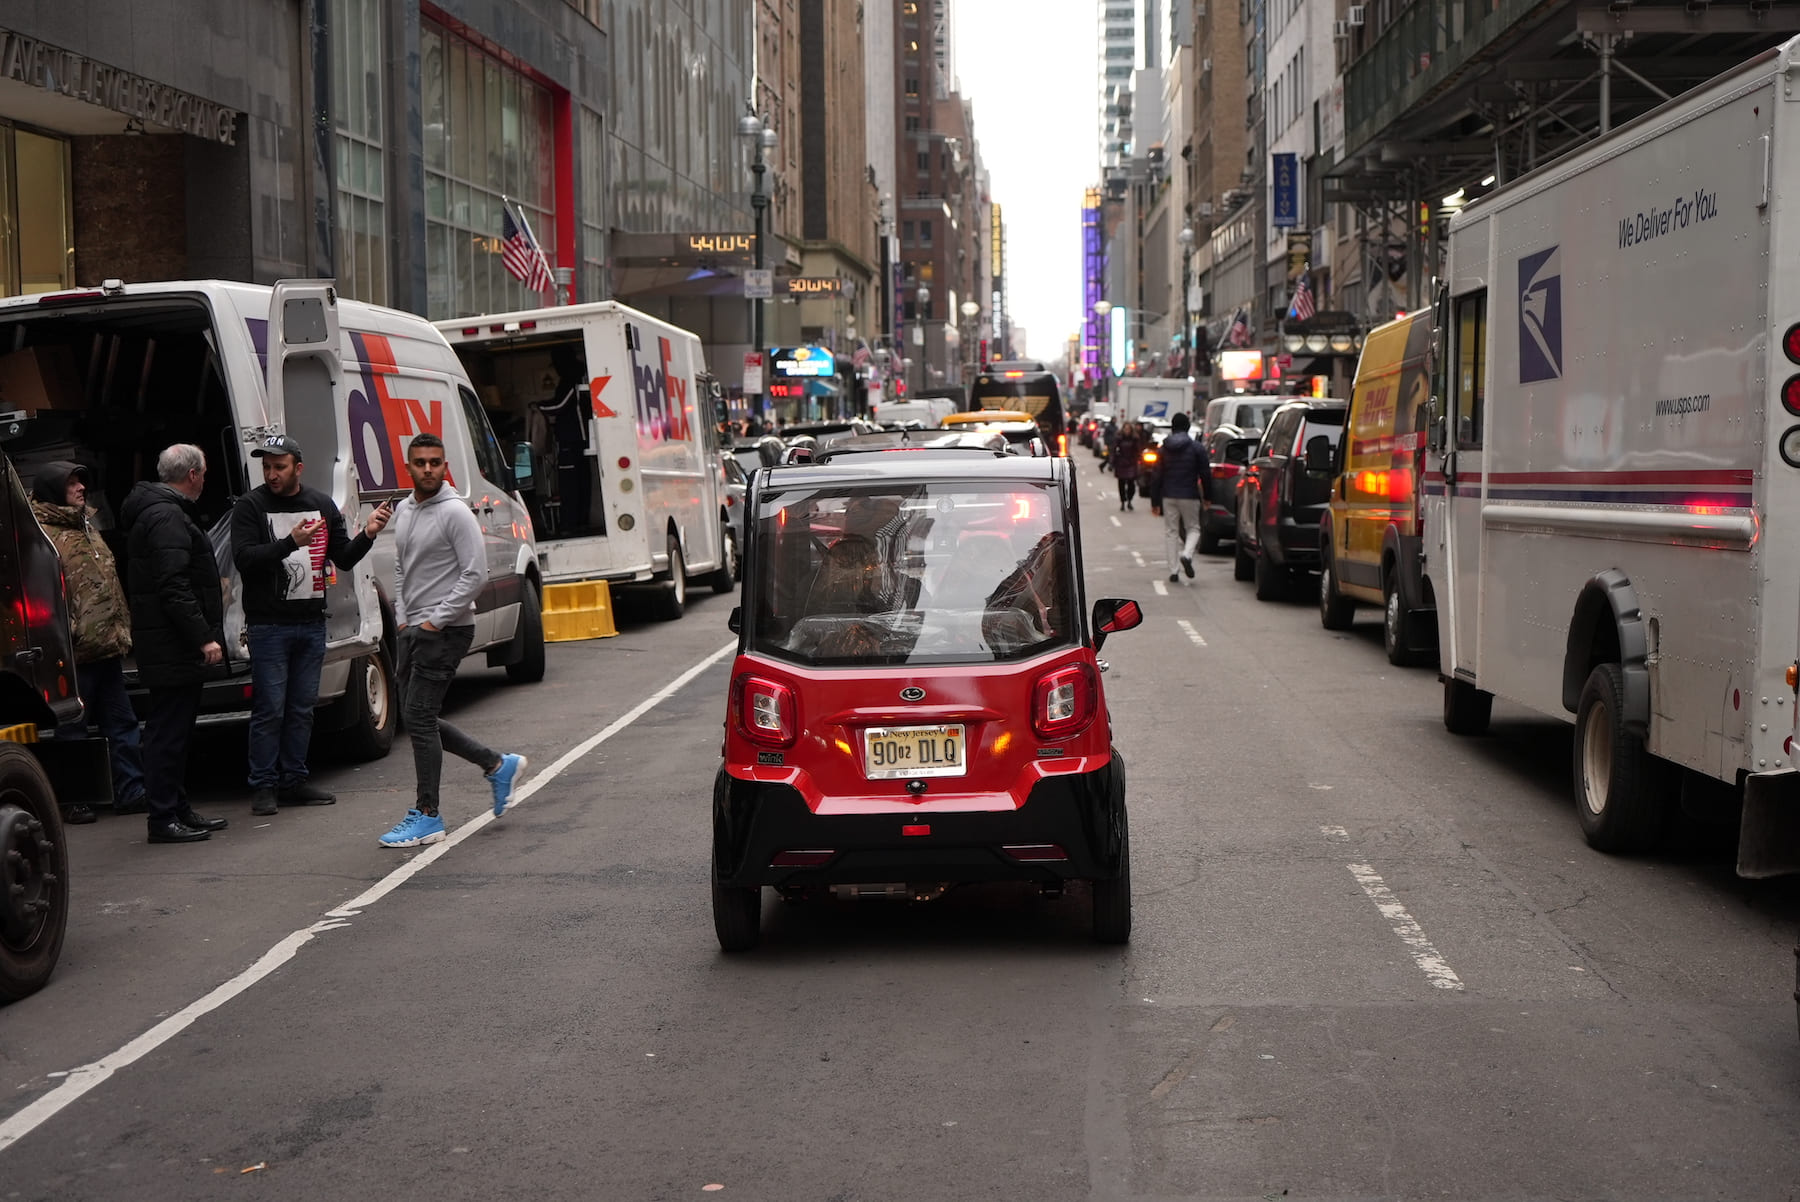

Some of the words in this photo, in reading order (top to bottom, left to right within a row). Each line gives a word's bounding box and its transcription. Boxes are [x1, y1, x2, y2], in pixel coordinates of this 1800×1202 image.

[159, 87, 237, 146] EXCHANGE
[1619, 217, 1634, 250] We
[1635, 207, 1673, 245] Deliver
[1673, 197, 1694, 231] For
[1695, 188, 1718, 223] You.
[631, 326, 692, 442] FedEx
[1655, 394, 1711, 419] www.usps.com
[890, 730, 909, 739] New
[911, 728, 939, 739] Jersey
[918, 738, 956, 764] DLQ
